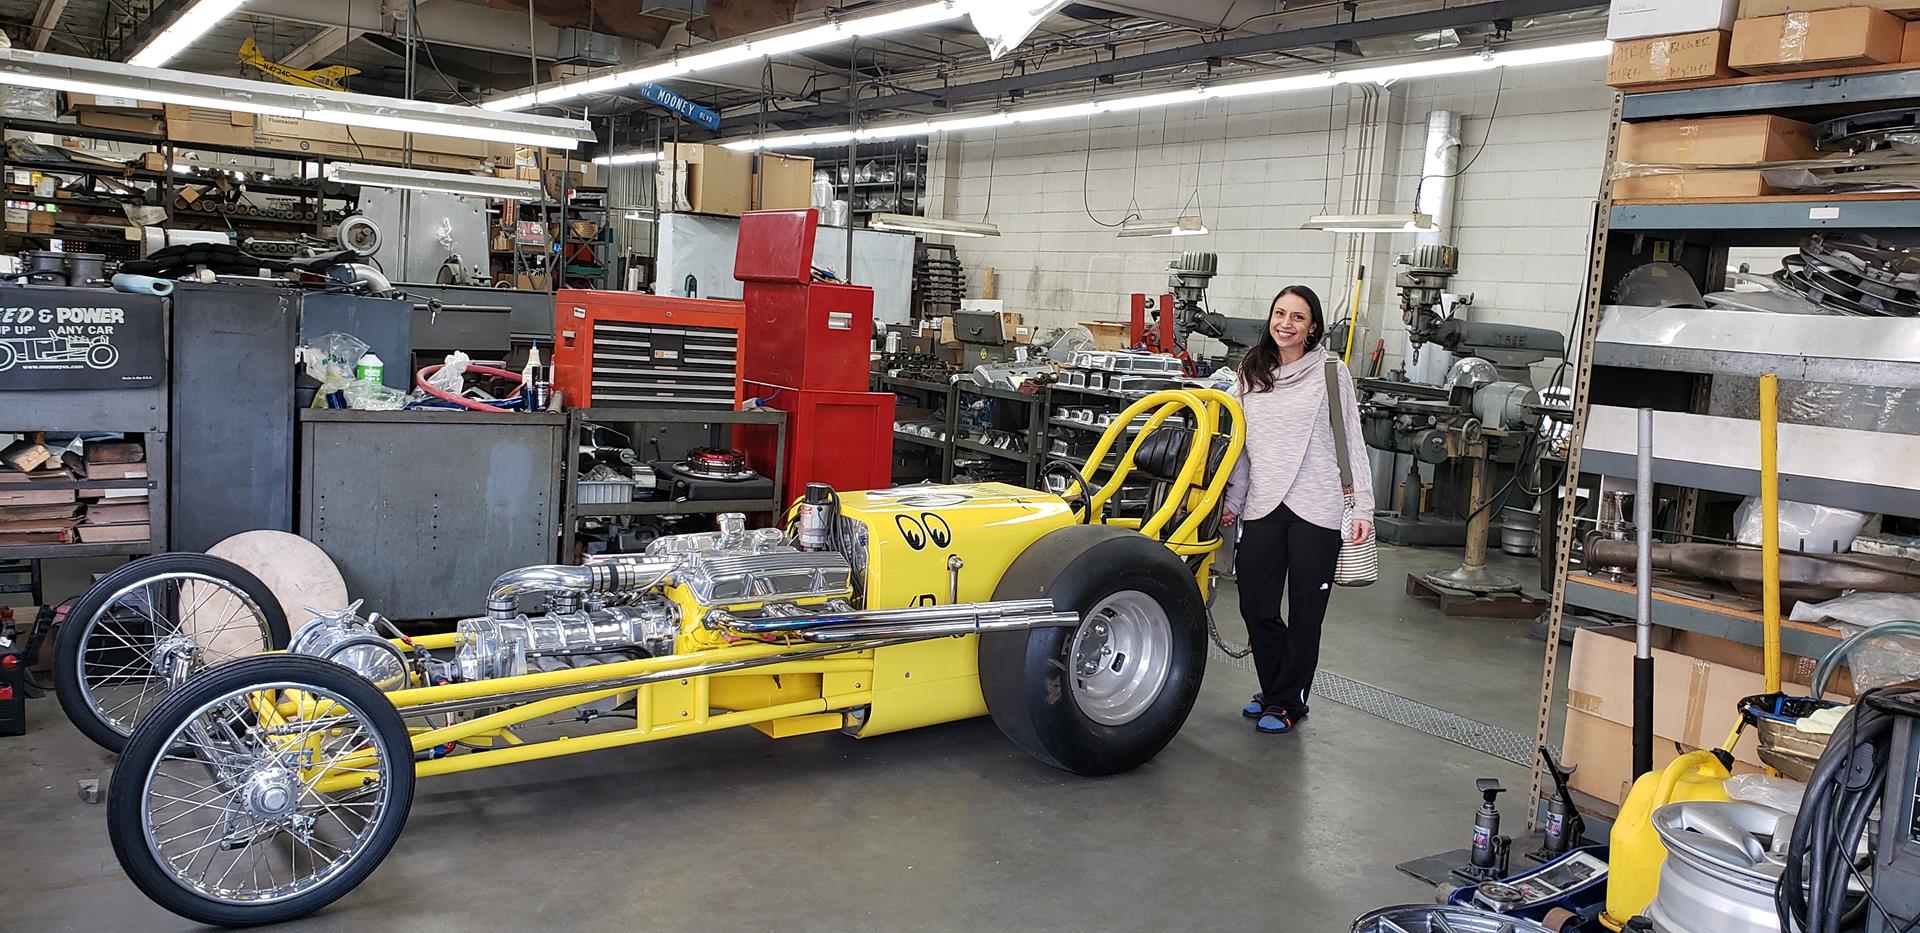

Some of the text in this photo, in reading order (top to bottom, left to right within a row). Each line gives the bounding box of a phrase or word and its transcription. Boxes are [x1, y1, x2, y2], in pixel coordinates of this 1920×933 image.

[657, 89, 713, 123] MOONEY BLVD
[268, 117, 299, 126] Fluorescent
[38, 308, 54, 323] &
[56, 307, 125, 324] POWER
[57, 325, 83, 335] ANY
[87, 325, 114, 335] CAR
